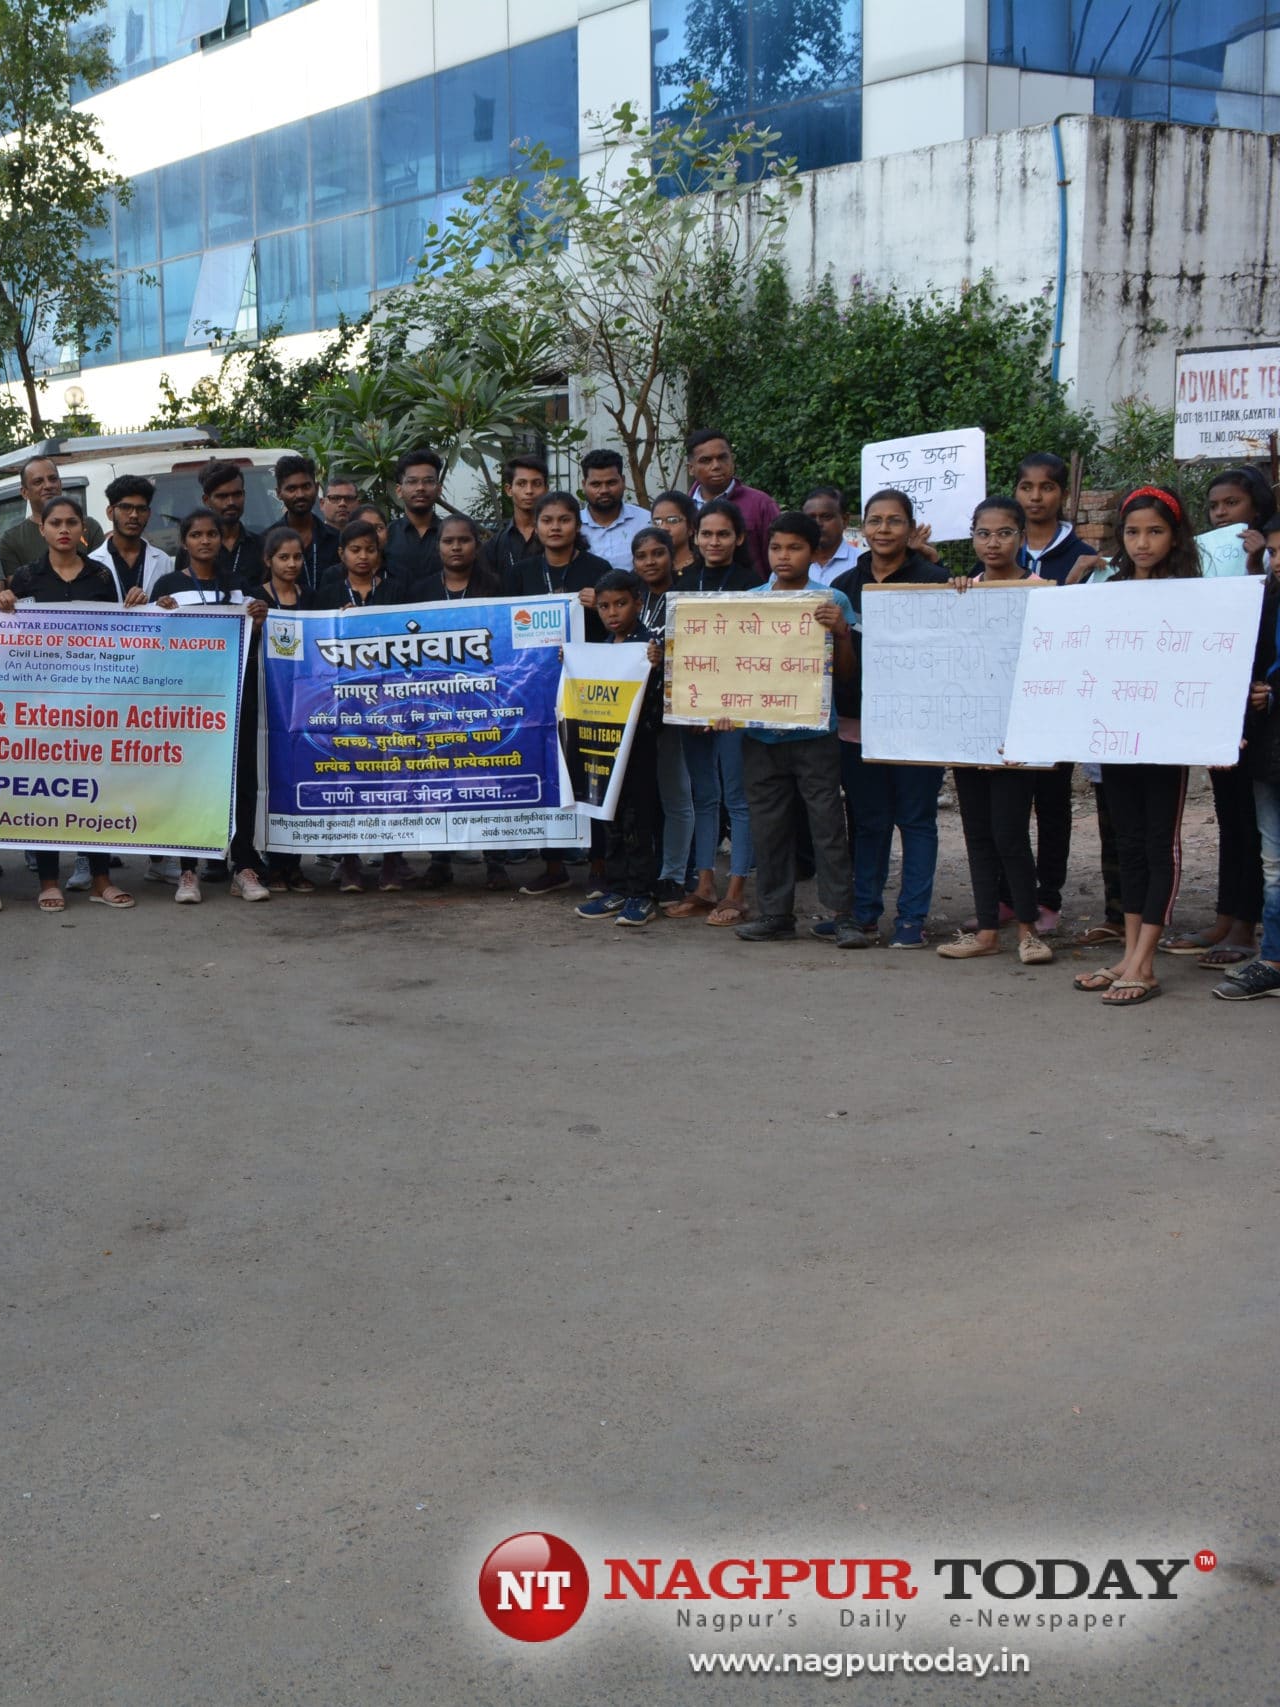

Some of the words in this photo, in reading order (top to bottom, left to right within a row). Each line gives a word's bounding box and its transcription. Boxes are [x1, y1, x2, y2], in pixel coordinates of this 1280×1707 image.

[1178, 367, 1249, 403] ADVANCE
[1258, 365, 1280, 398] TE
[920, 445, 967, 465] कदम
[43, 622, 108, 632] EDUCATIONS
[110, 623, 162, 633] SOCIETY'S
[532, 609, 561, 629] OCW
[683, 619, 709, 635] मन
[738, 612, 764, 635] रखो
[771, 620, 792, 636] एक
[46, 634, 65, 647] OF
[67, 635, 116, 648] SOCIAL
[119, 636, 166, 651] WORK,
[169, 638, 227, 651] NAGPUR
[315, 619, 493, 671] जलसंवाद
[1032, 626, 1054, 652] देश
[1105, 630, 1149, 651] साफ
[1157, 619, 1193, 652] होगा
[1203, 632, 1240, 653] जब
[8, 649, 31, 658] Civil
[33, 650, 63, 660] Lines,
[65, 650, 97, 660] Sadar,
[99, 651, 136, 662] Nagpur
[4, 661, 21, 671] (An
[24, 661, 91, 672] Autonomous
[93, 662, 139, 674] Institute)
[780, 657, 822, 674] बनाना
[12, 672, 33, 682] with
[35, 673, 47, 682] A+
[50, 673, 79, 683] Grade
[81, 675, 92, 686] by
[95, 675, 110, 684] the
[113, 676, 140, 685] NAAC
[142, 676, 183, 687] Banglore
[332, 683, 378, 705] नागपूर
[383, 672, 497, 698] महानगरपालिका
[587, 685, 620, 702] UPAY
[1112, 680, 1158, 702] सबका
[721, 694, 754, 709] भारत
[14, 702, 119, 729] Extension
[125, 704, 227, 731] Activities
[340, 711, 362, 725] सिटी
[365, 711, 388, 725] वॉटर
[428, 707, 453, 722] यांचा
[455, 706, 488, 723] संयुक्त
[490, 706, 524, 718] उपक्रम
[332, 735, 373, 749] स्वच्छ,
[376, 731, 421, 751] सुरक्षित,
[425, 731, 468, 750] मुबलक
[471, 726, 502, 743] पाणी
[597, 728, 622, 743] TEACH
[110, 738, 184, 764] Efforts
[314, 756, 351, 774] प्रत्येक
[355, 756, 402, 773] घरासाठी
[453, 750, 523, 770] प्रत्येकासाठी
[321, 787, 355, 805] पाणी
[65, 813, 138, 833] Project)
[425, 816, 442, 826] OCW
[452, 816, 468, 825] OCW
